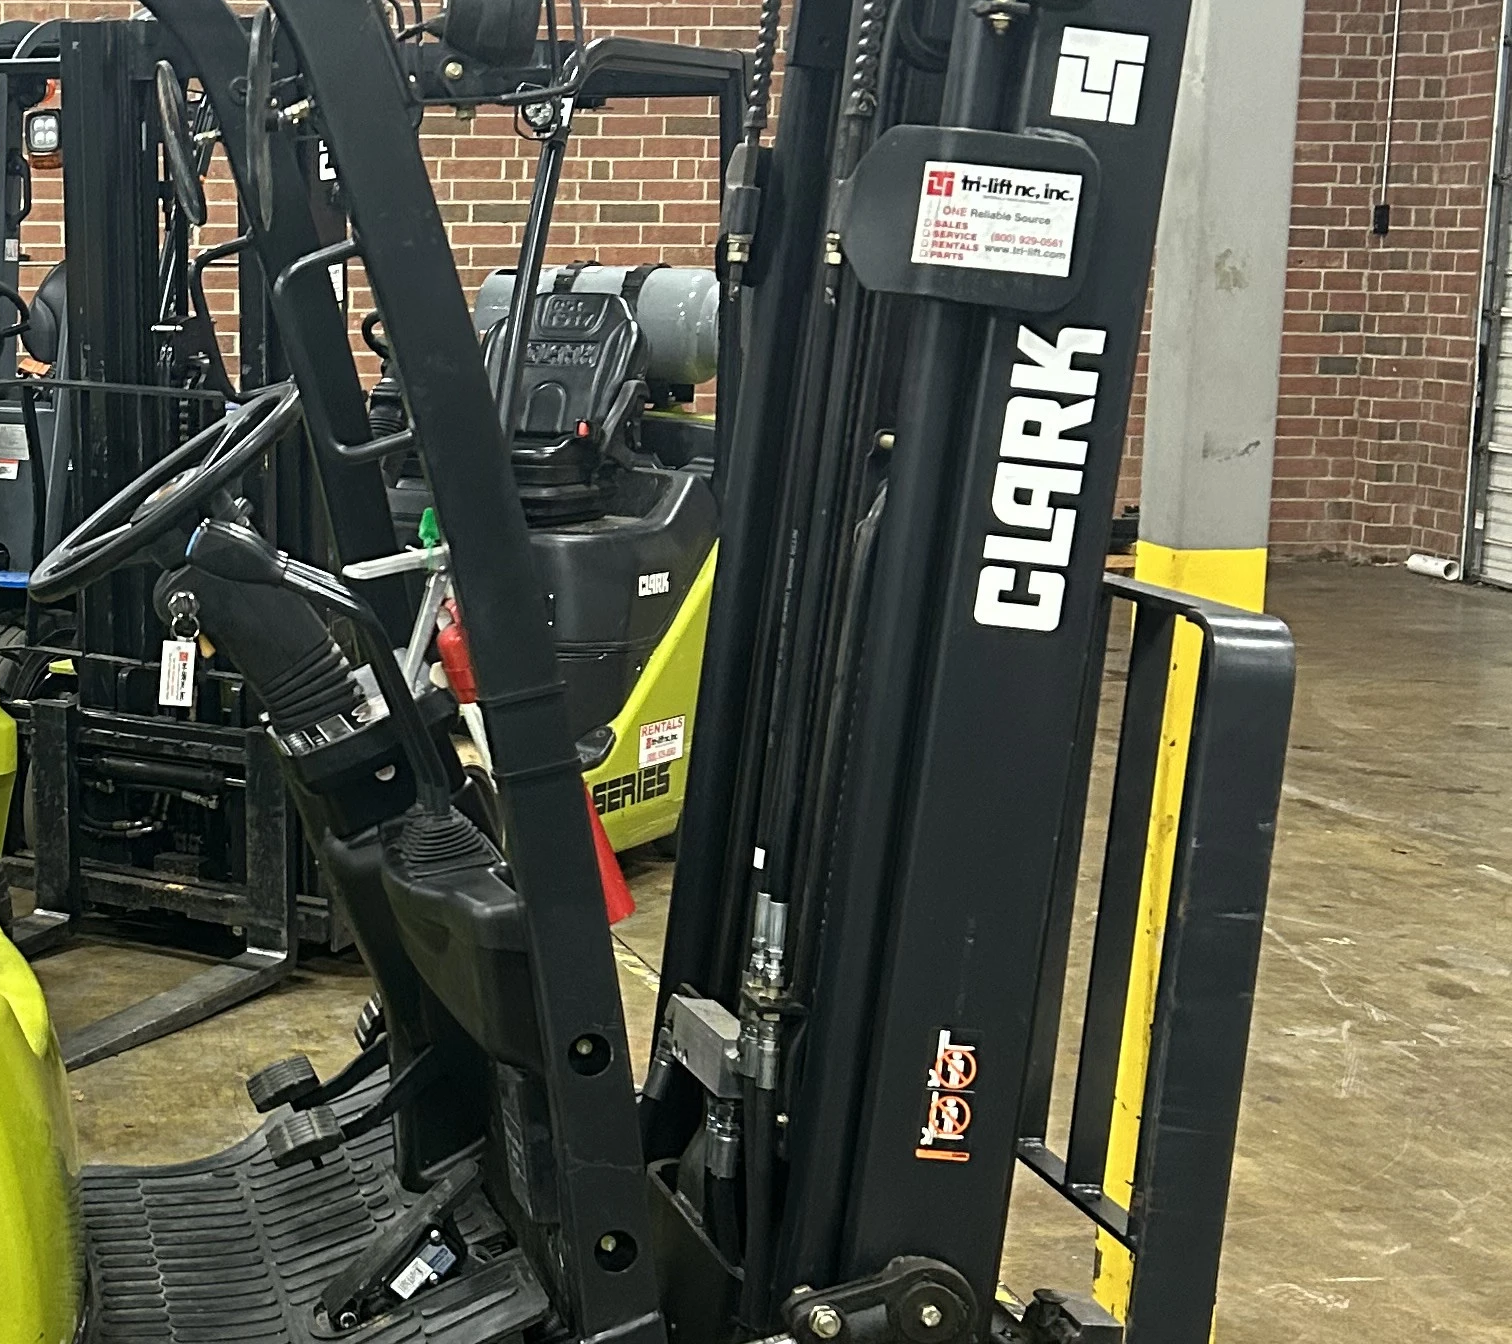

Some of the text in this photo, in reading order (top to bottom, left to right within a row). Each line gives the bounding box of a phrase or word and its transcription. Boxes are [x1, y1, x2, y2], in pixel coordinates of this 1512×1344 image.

[961, 174, 1013, 195] tri-lift
[1044, 183, 1075, 201] inc.
[942, 205, 1051, 225] ONE Reliable Source
[933, 219, 968, 230] SALES
[932, 230, 977, 241] SERVICE
[990, 232, 1064, 248] (800) 929-0561
[931, 240, 979, 252] RENTALS
[984, 244, 1067, 260] www.tri-lift.com
[929, 250, 964, 261] PARTS
[973, 323, 1107, 633] CLARK
[638, 571, 670, 597] CLARK
[640, 717, 683, 737] RENTALS
[592, 761, 671, 816] SERIES
